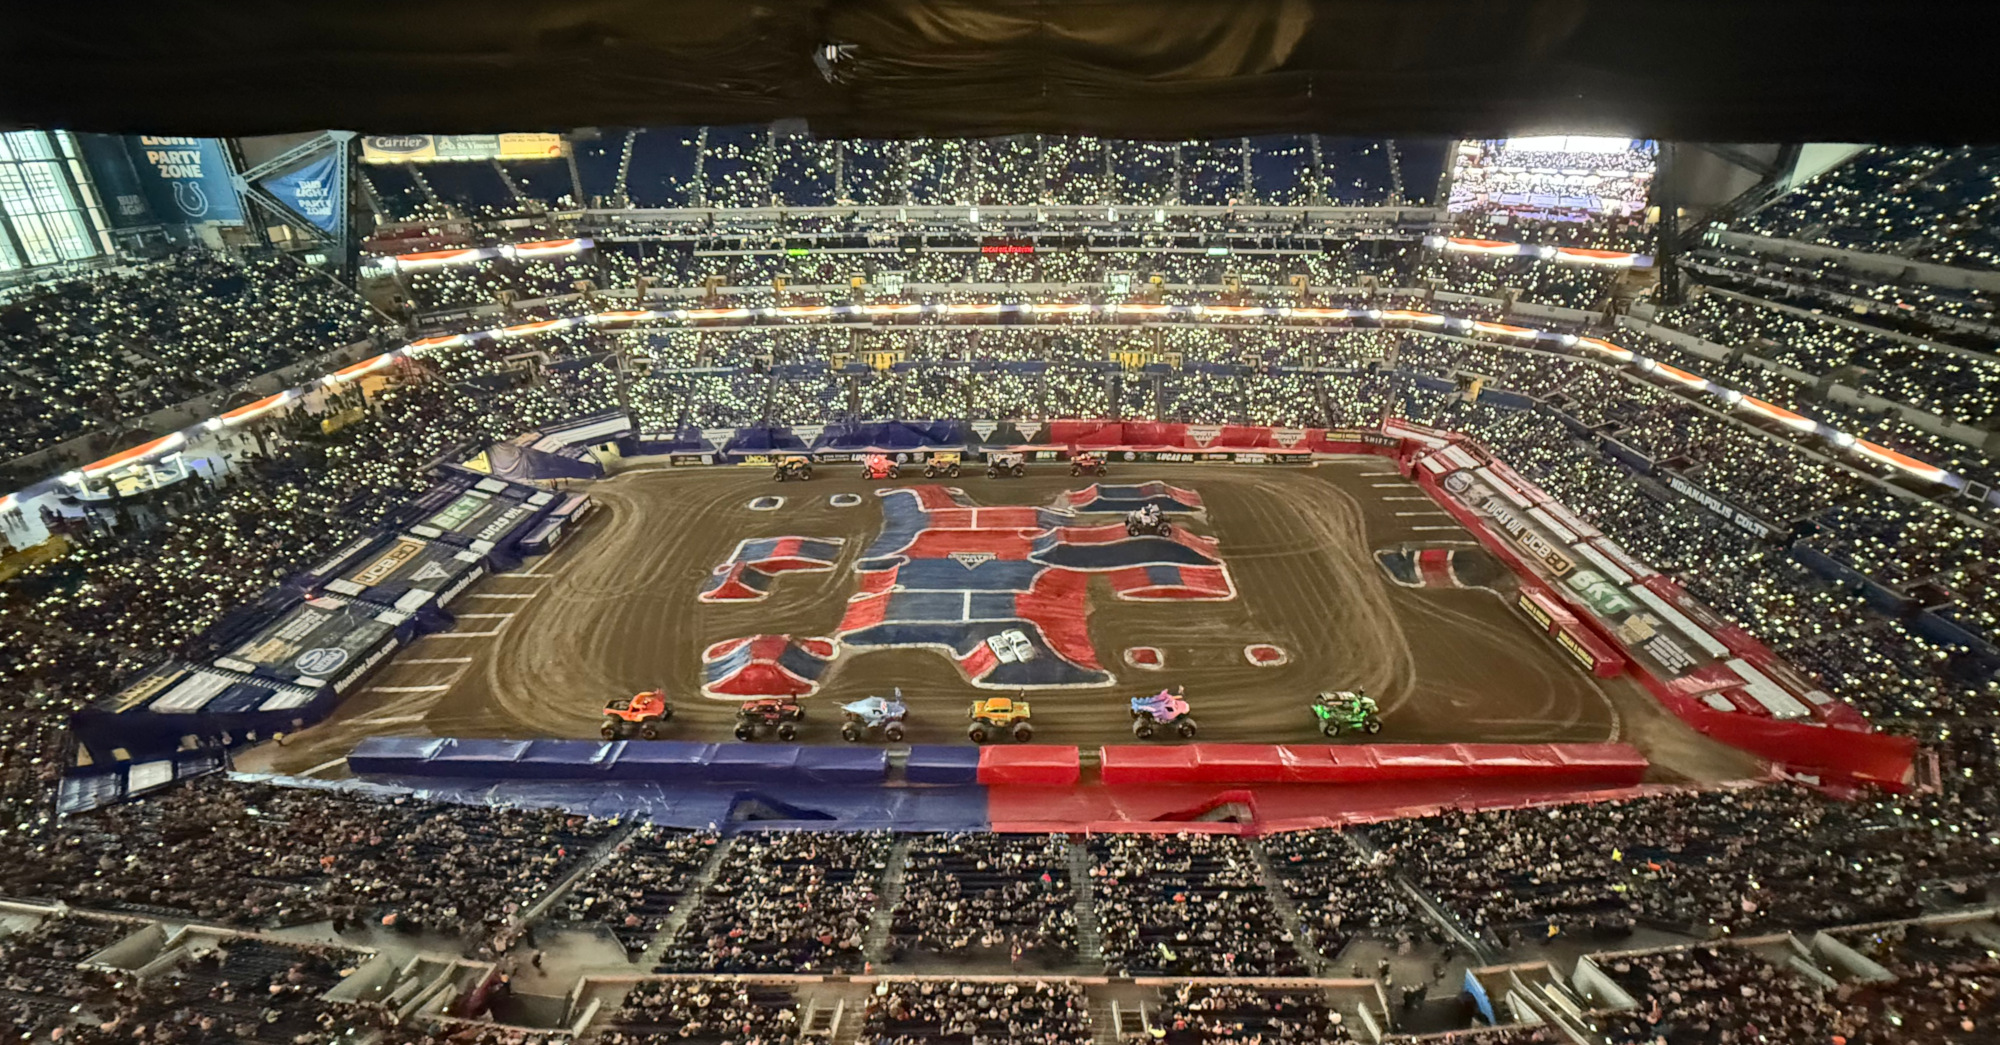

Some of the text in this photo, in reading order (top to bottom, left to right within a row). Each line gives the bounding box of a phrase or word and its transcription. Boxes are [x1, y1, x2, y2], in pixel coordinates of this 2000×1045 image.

[375, 137, 422, 147] Carrier
[147, 151, 200, 164] PARTY
[158, 165, 203, 178] ZONE
[296, 187, 328, 197] LIGHT
[299, 199, 331, 208] PARTY
[306, 206, 332, 216] ZONE
[1156, 453, 1179, 461] LUCAS
[434, 498, 480, 528] BKT
[1668, 477, 1769, 539] NDIANAPOLIS COLTS
[1481, 500, 1524, 536] LUCAS OIL
[478, 516, 510, 540] LUCAS
[1523, 534, 1550, 557] JCB
[365, 558, 398, 583] JCB
[1573, 572, 1632, 610] BKT
